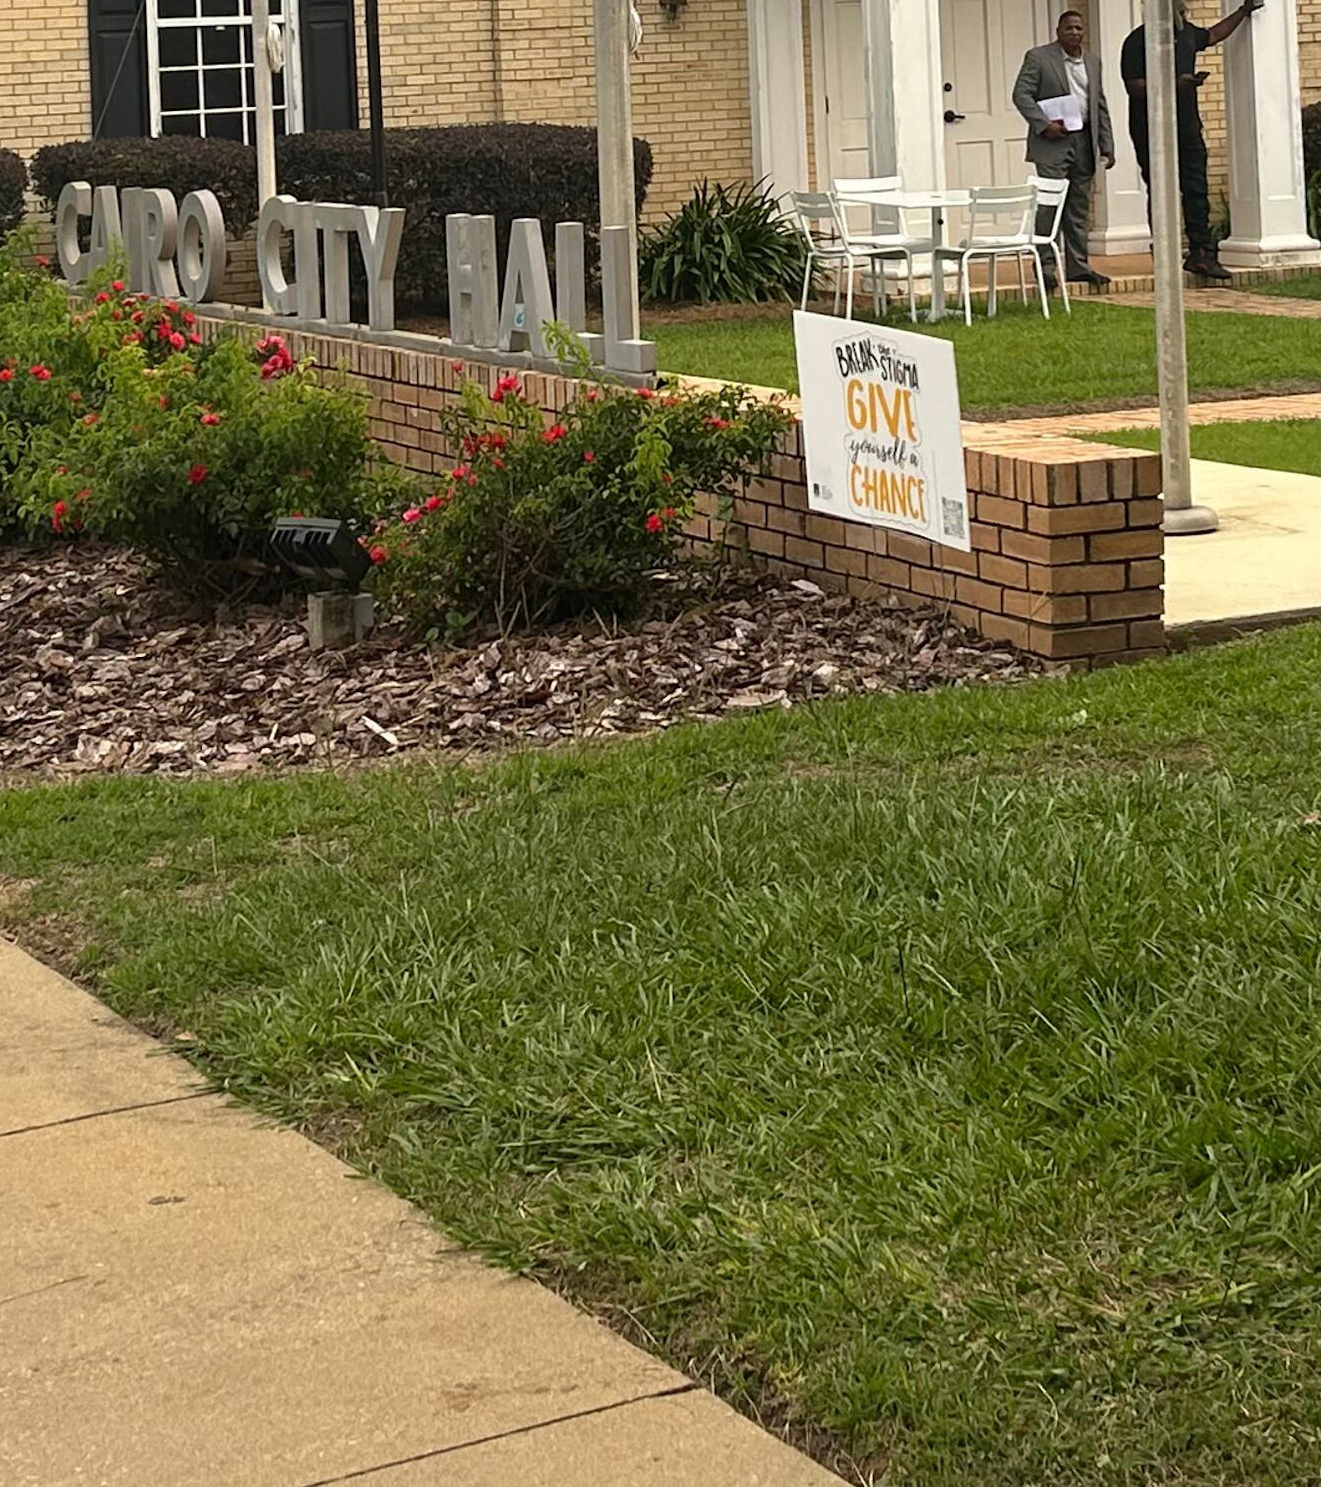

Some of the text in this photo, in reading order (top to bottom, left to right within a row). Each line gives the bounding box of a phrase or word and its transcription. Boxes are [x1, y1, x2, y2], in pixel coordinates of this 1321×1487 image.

[56, 180, 656, 373] CAIRO CITY HALL
[835, 338, 879, 378] BREAK
[880, 355, 920, 390] STIGMA
[847, 379, 917, 442] GIVE
[849, 436, 919, 469] yourself a
[850, 463, 927, 523] CHANCE
